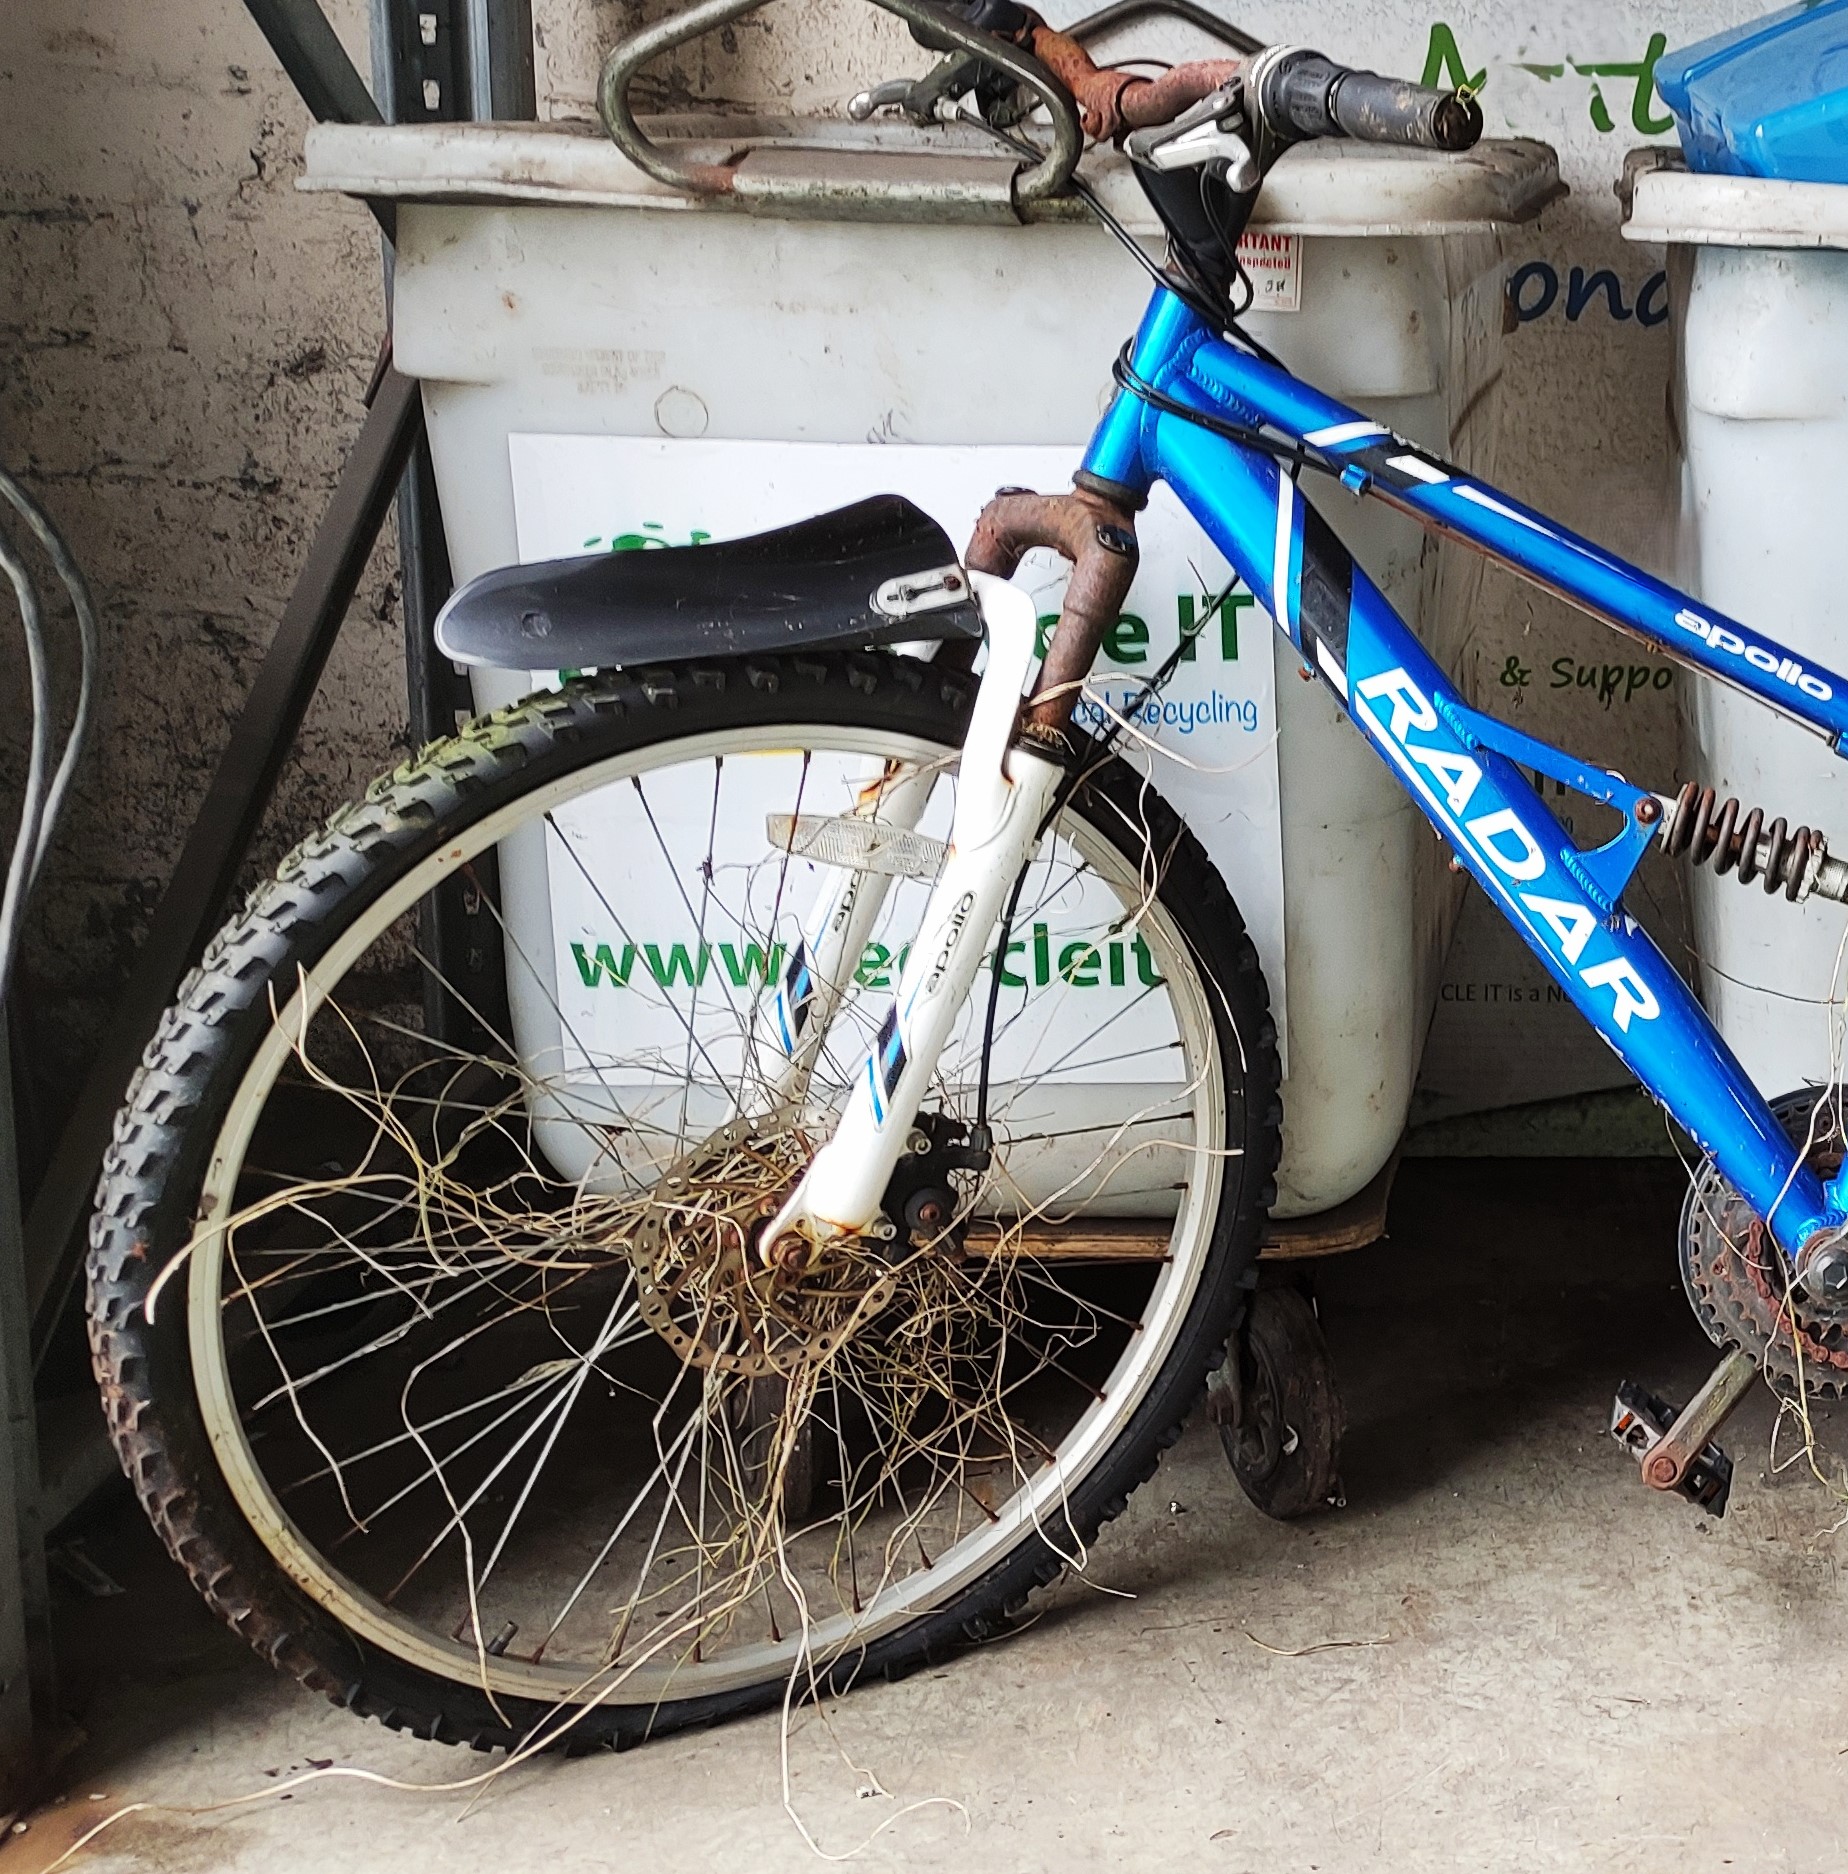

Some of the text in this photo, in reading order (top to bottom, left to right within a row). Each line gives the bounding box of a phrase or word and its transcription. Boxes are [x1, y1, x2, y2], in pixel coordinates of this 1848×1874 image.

[1178, 593, 1255, 662] IT
[1674, 609, 1833, 701] apollo
[1500, 656, 1531, 687] &
[1123, 690, 1257, 733] Recycling
[1357, 667, 1660, 1034] RADAR
[926, 891, 975, 994] apollo
[1484, 984, 1503, 1002] IT
[1508, 984, 1523, 1001] is
[1529, 988, 1540, 1001] a
